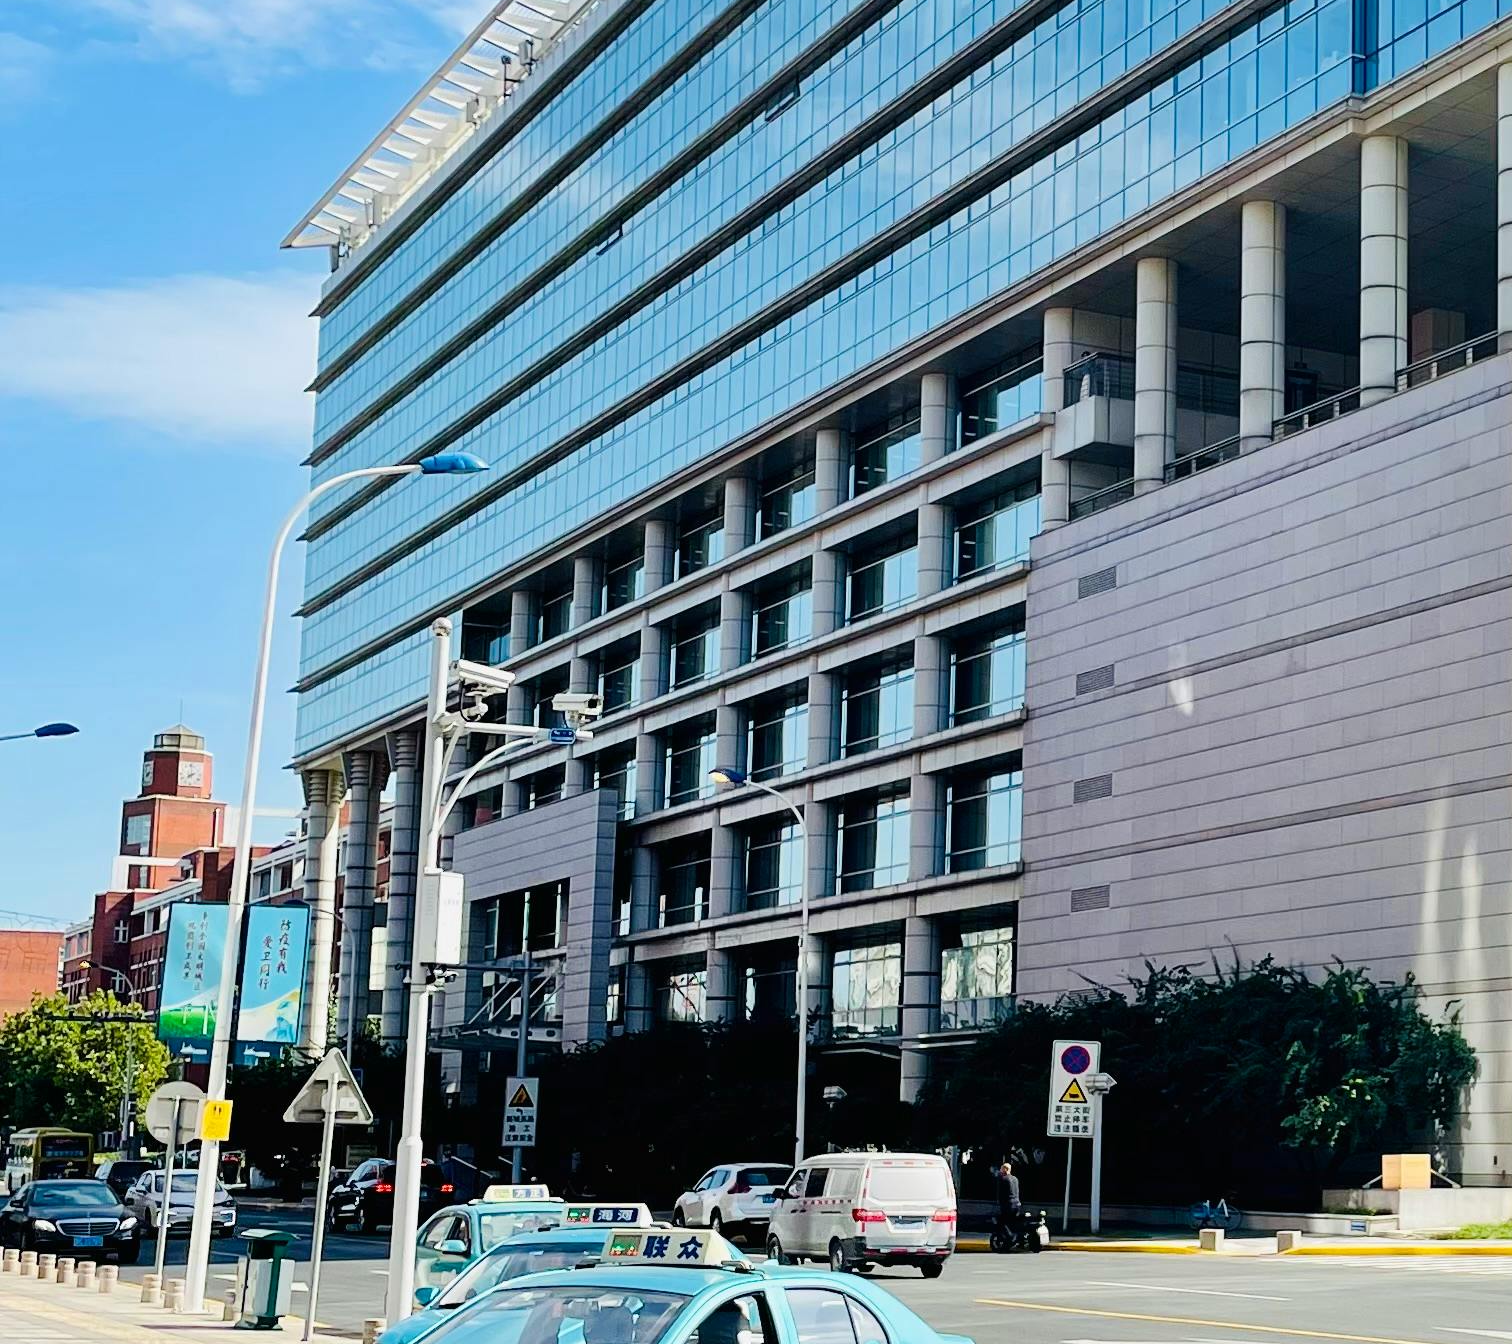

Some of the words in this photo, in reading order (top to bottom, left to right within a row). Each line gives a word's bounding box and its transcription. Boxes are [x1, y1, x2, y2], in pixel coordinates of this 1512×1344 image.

[258, 935, 274, 991] 爱卫同行
[277, 919, 292, 974] 防疫有我
[598, 1209, 634, 1222] 海河
[643, 1235, 704, 1259] 联众
